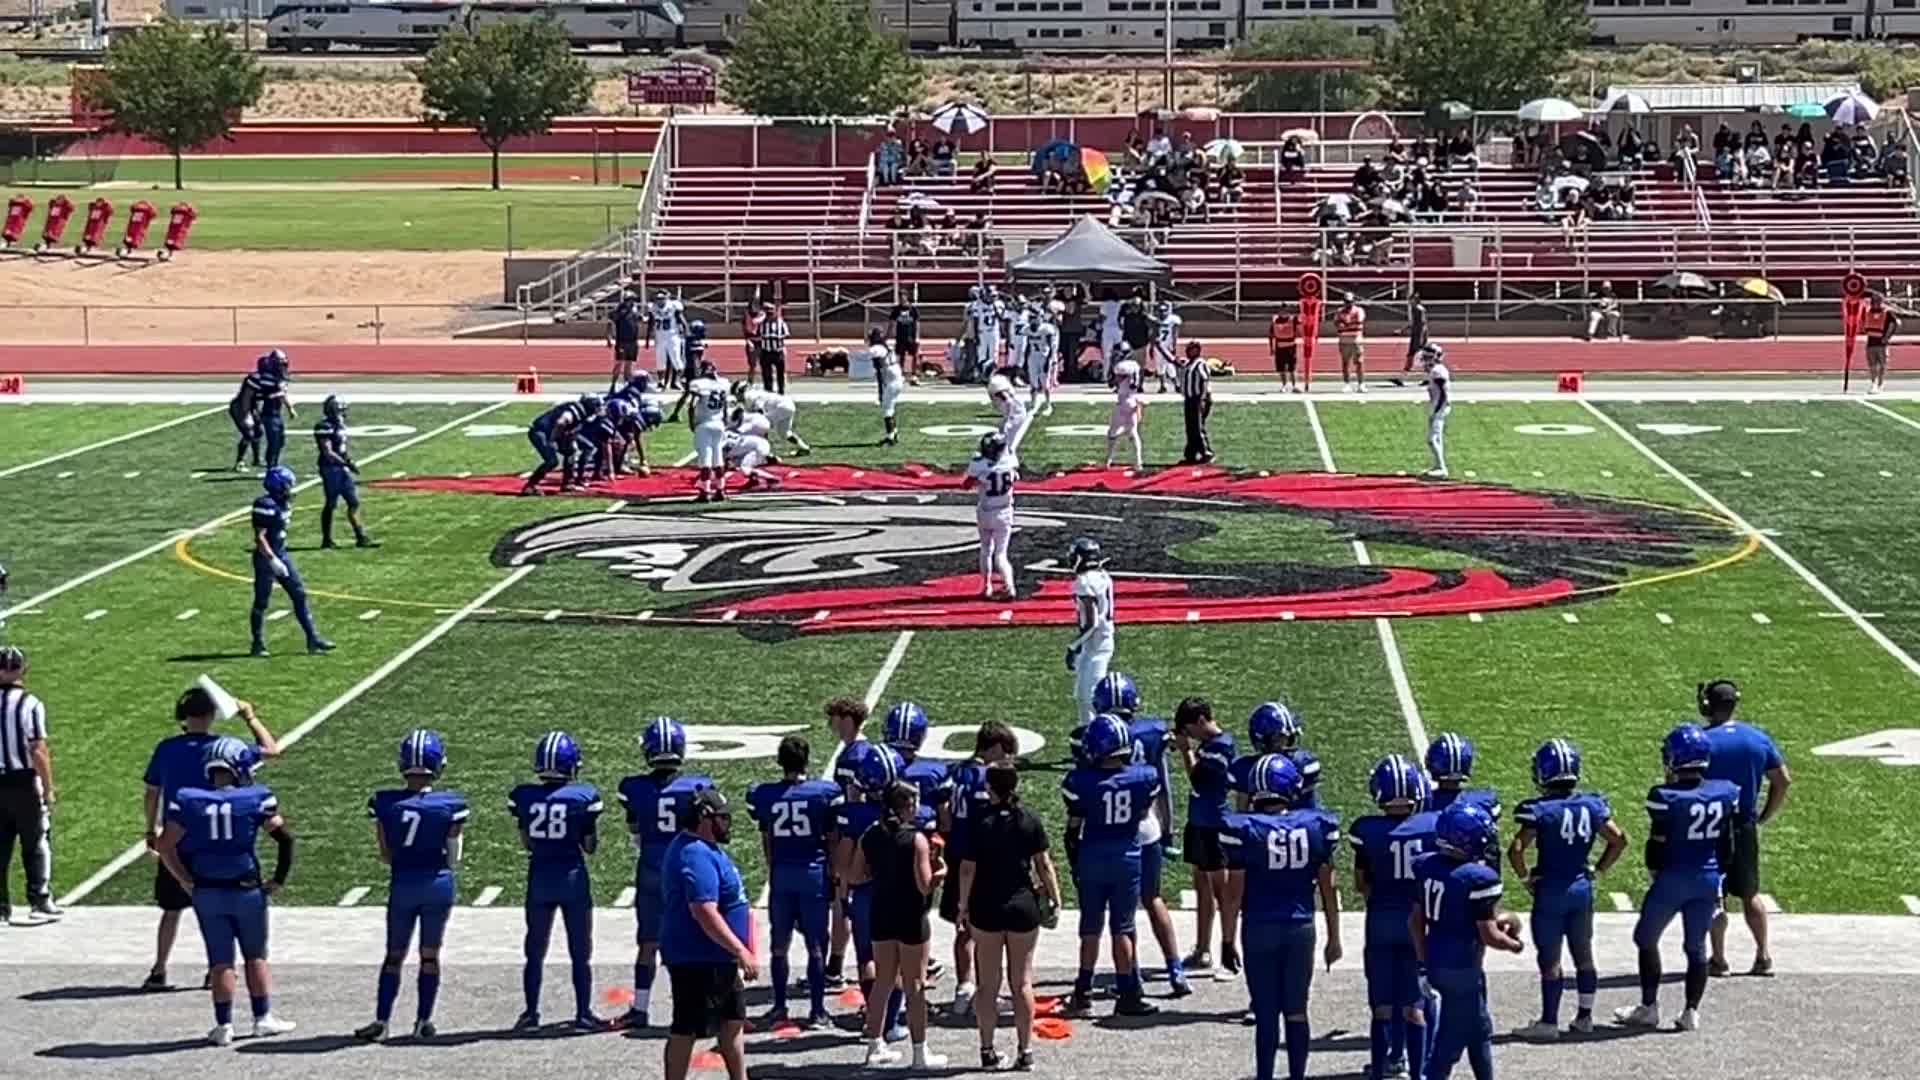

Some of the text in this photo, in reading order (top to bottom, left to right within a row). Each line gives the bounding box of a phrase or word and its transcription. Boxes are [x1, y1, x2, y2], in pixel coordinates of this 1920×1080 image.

[205, 802, 233, 840] 11
[528, 802, 567, 839] 28
[657, 797, 676, 832] 5
[771, 800, 812, 837] 25
[1101, 789, 1132, 824] 18
[1560, 805, 1592, 845] 44
[1687, 801, 1723, 840] 22
[402, 809, 421, 847] 7
[1267, 827, 1309, 870] 60
[1424, 877, 1445, 921] 17
